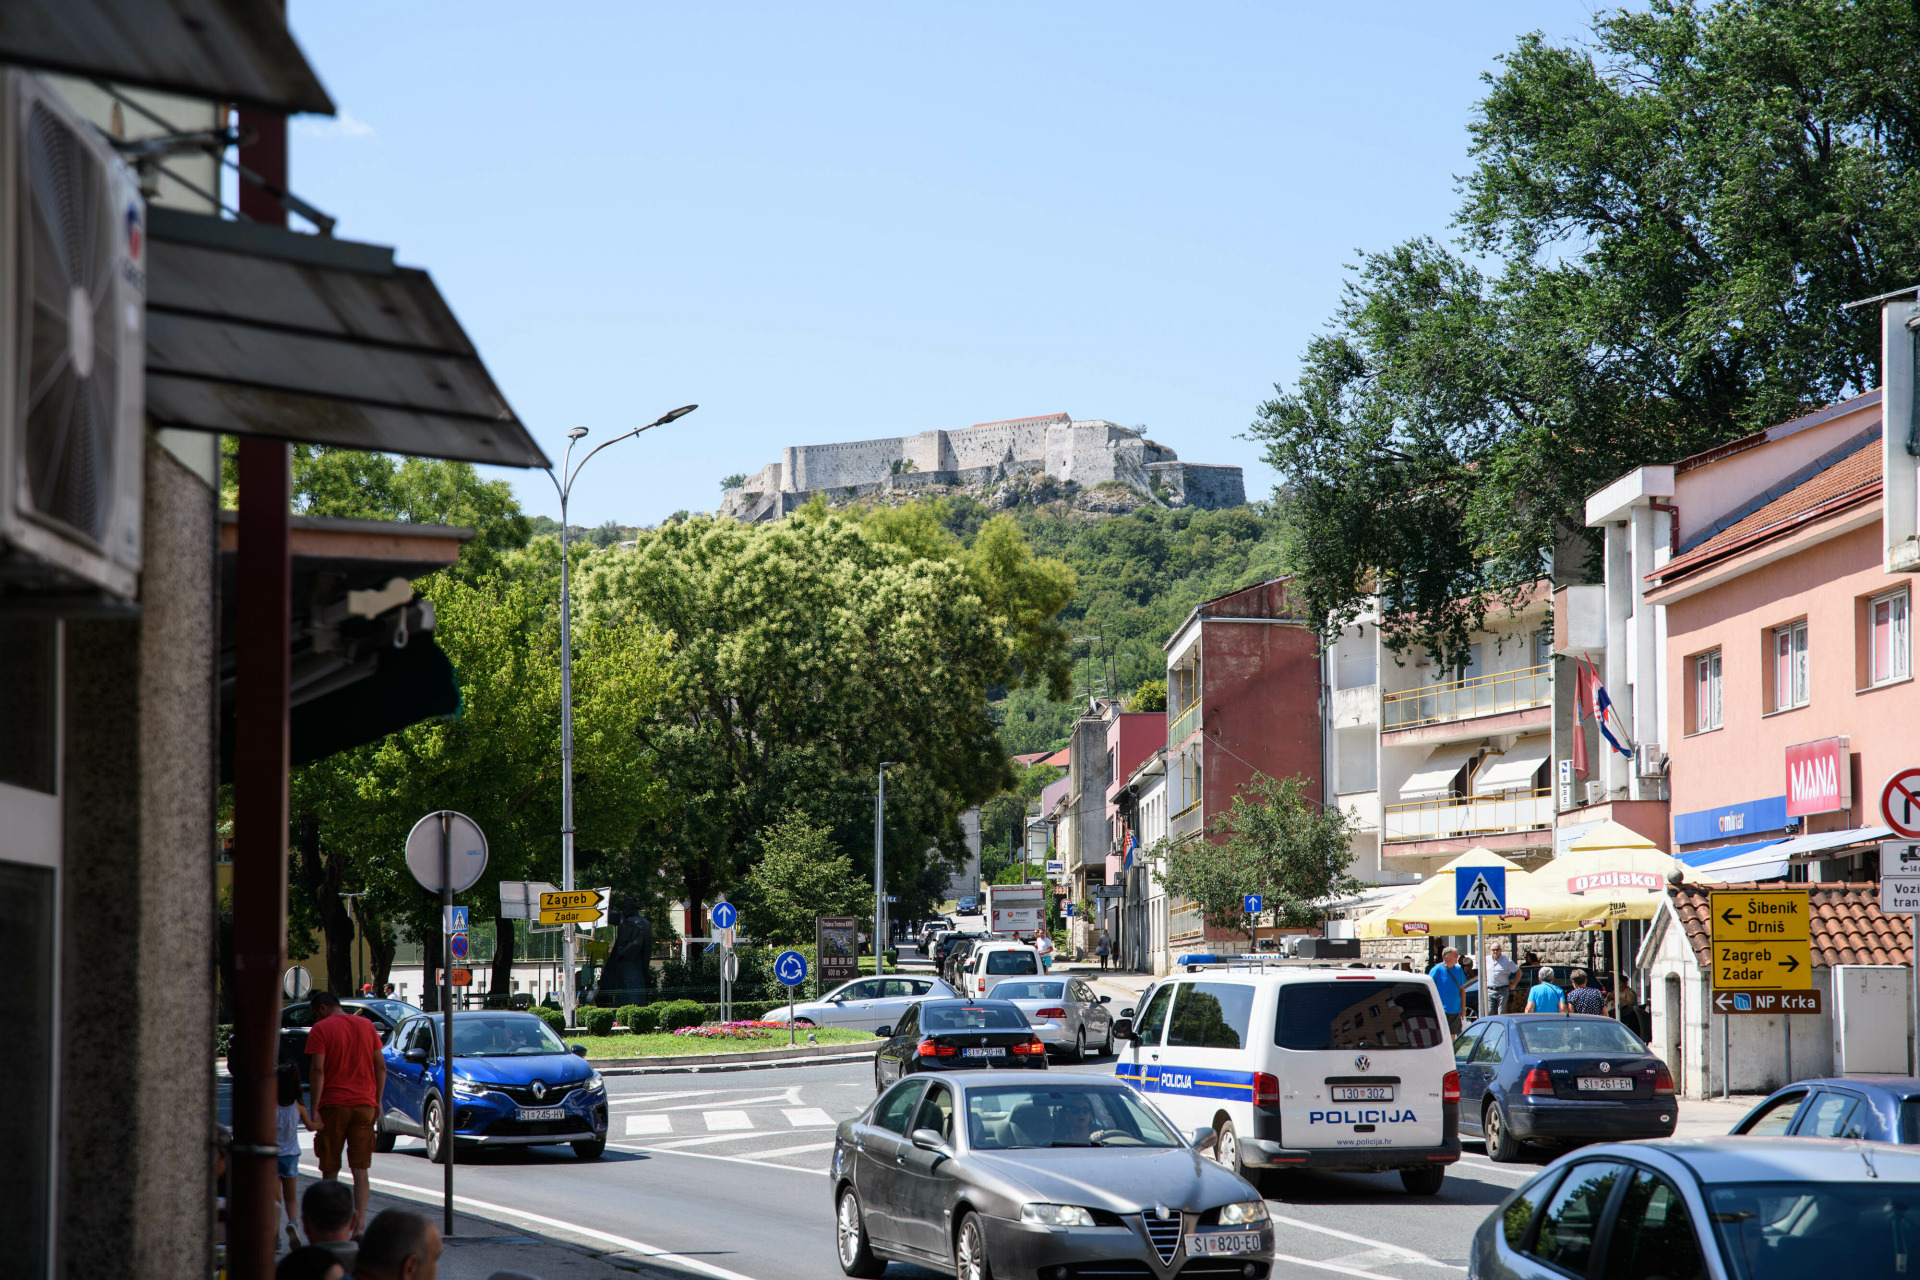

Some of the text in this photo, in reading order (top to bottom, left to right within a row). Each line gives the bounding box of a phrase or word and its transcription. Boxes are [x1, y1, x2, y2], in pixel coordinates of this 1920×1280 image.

[1791, 755, 1838, 802] MANA
[1724, 810, 1745, 832] mlinar
[1576, 872, 1657, 890] Ožujsko
[547, 893, 587, 906] Zagreb
[1609, 901, 1627, 911] ŽUJA
[1748, 898, 1798, 914] Šibenik
[555, 912, 580, 921] Zadar
[1748, 920, 1785, 933] Drniš
[1722, 949, 1772, 964] Zagreb
[1722, 968, 1763, 980] Zadar
[1756, 995, 1816, 1009] NP Krka
[967, 1049, 975, 1057] SI
[1161, 1073, 1192, 1089] POLICIJA
[1584, 1079, 1631, 1089] SI 261-EH
[1342, 1088, 1385, 1099] 130 302
[521, 1110, 564, 1120] SI 245-HV
[1309, 1110, 1417, 1124] POLICIJA
[1337, 1138, 1392, 1147] www.policija.hr
[1194, 1237, 1208, 1252] SI
